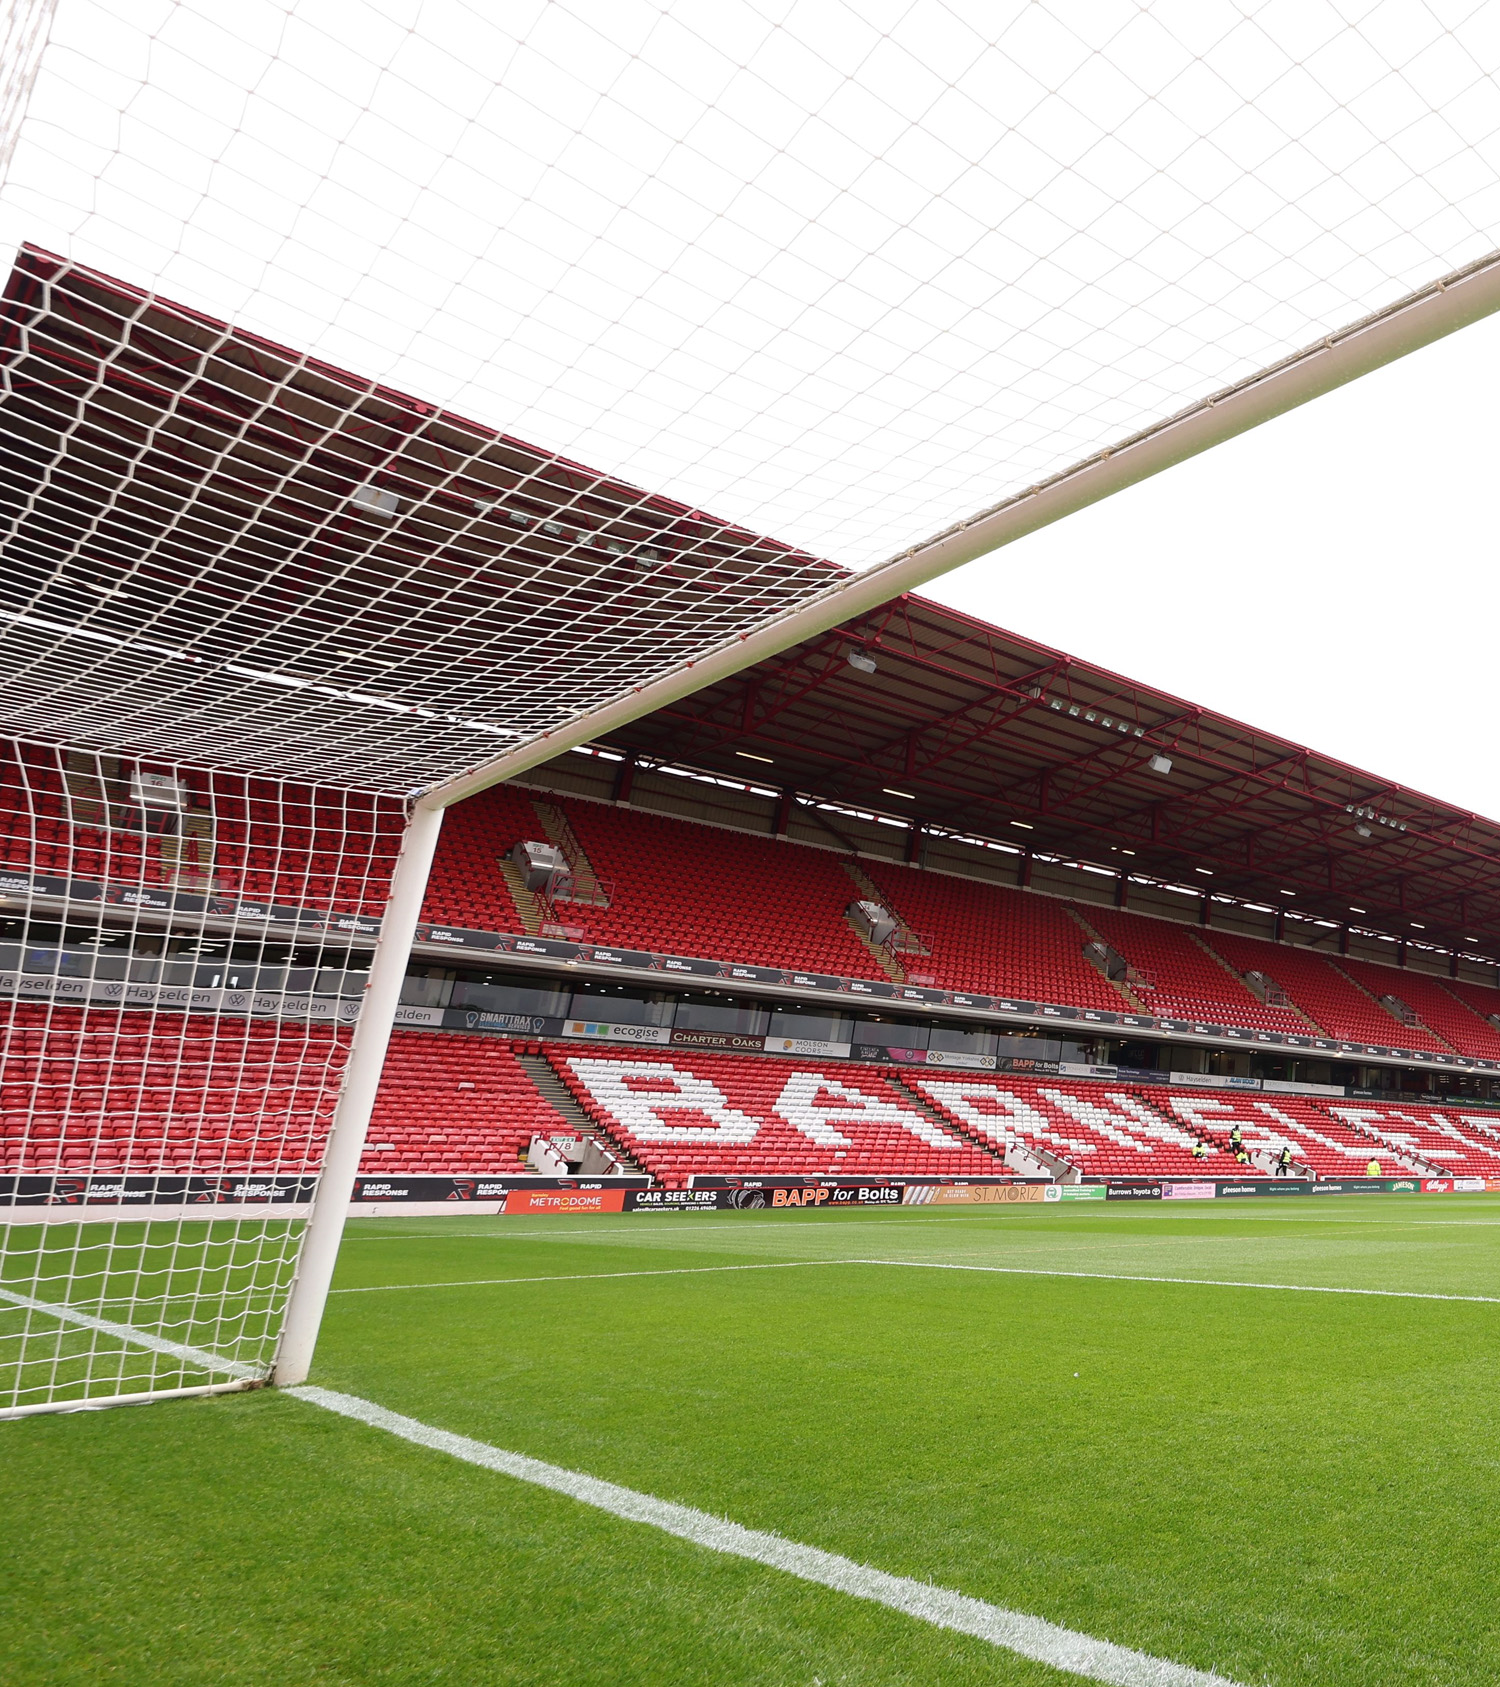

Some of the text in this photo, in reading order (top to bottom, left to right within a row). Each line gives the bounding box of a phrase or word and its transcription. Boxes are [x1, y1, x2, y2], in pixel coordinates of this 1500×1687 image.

[0, 877, 29, 885] RAPID
[125, 892, 151, 900] RAPID
[123, 897, 167, 907] RESPONSE
[338, 923, 374, 932] RESPONSE
[431, 935, 464, 943] RESPONSE
[516, 945, 547, 953] RESPONSE
[127, 986, 211, 1002] Hayselden
[253, 997, 327, 1012] Hayselden
[395, 1010, 431, 1020] elden
[480, 1012, 532, 1025] SMARTTRAX
[614, 1026, 659, 1039] ecogise
[674, 1032, 727, 1044] CHARTER
[732, 1038, 762, 1048] OAKS
[795, 1046, 821, 1054] COORS
[1012, 1059, 1035, 1068] BAPP
[1186, 1075, 1212, 1083] Hayselden
[1222, 1186, 1241, 1194] gleeson
[1312, 1184, 1329, 1192] gleeson
[1392, 1180, 1415, 1191] JAMESON
[636, 1189, 717, 1202] CAR SEEKERS
[772, 1187, 899, 1207] BAPP for Bolts
[973, 1187, 1039, 1202] ST. MORIZ
[1133, 1188, 1151, 1196] Toyota
[529, 1196, 602, 1207] METRODOME
